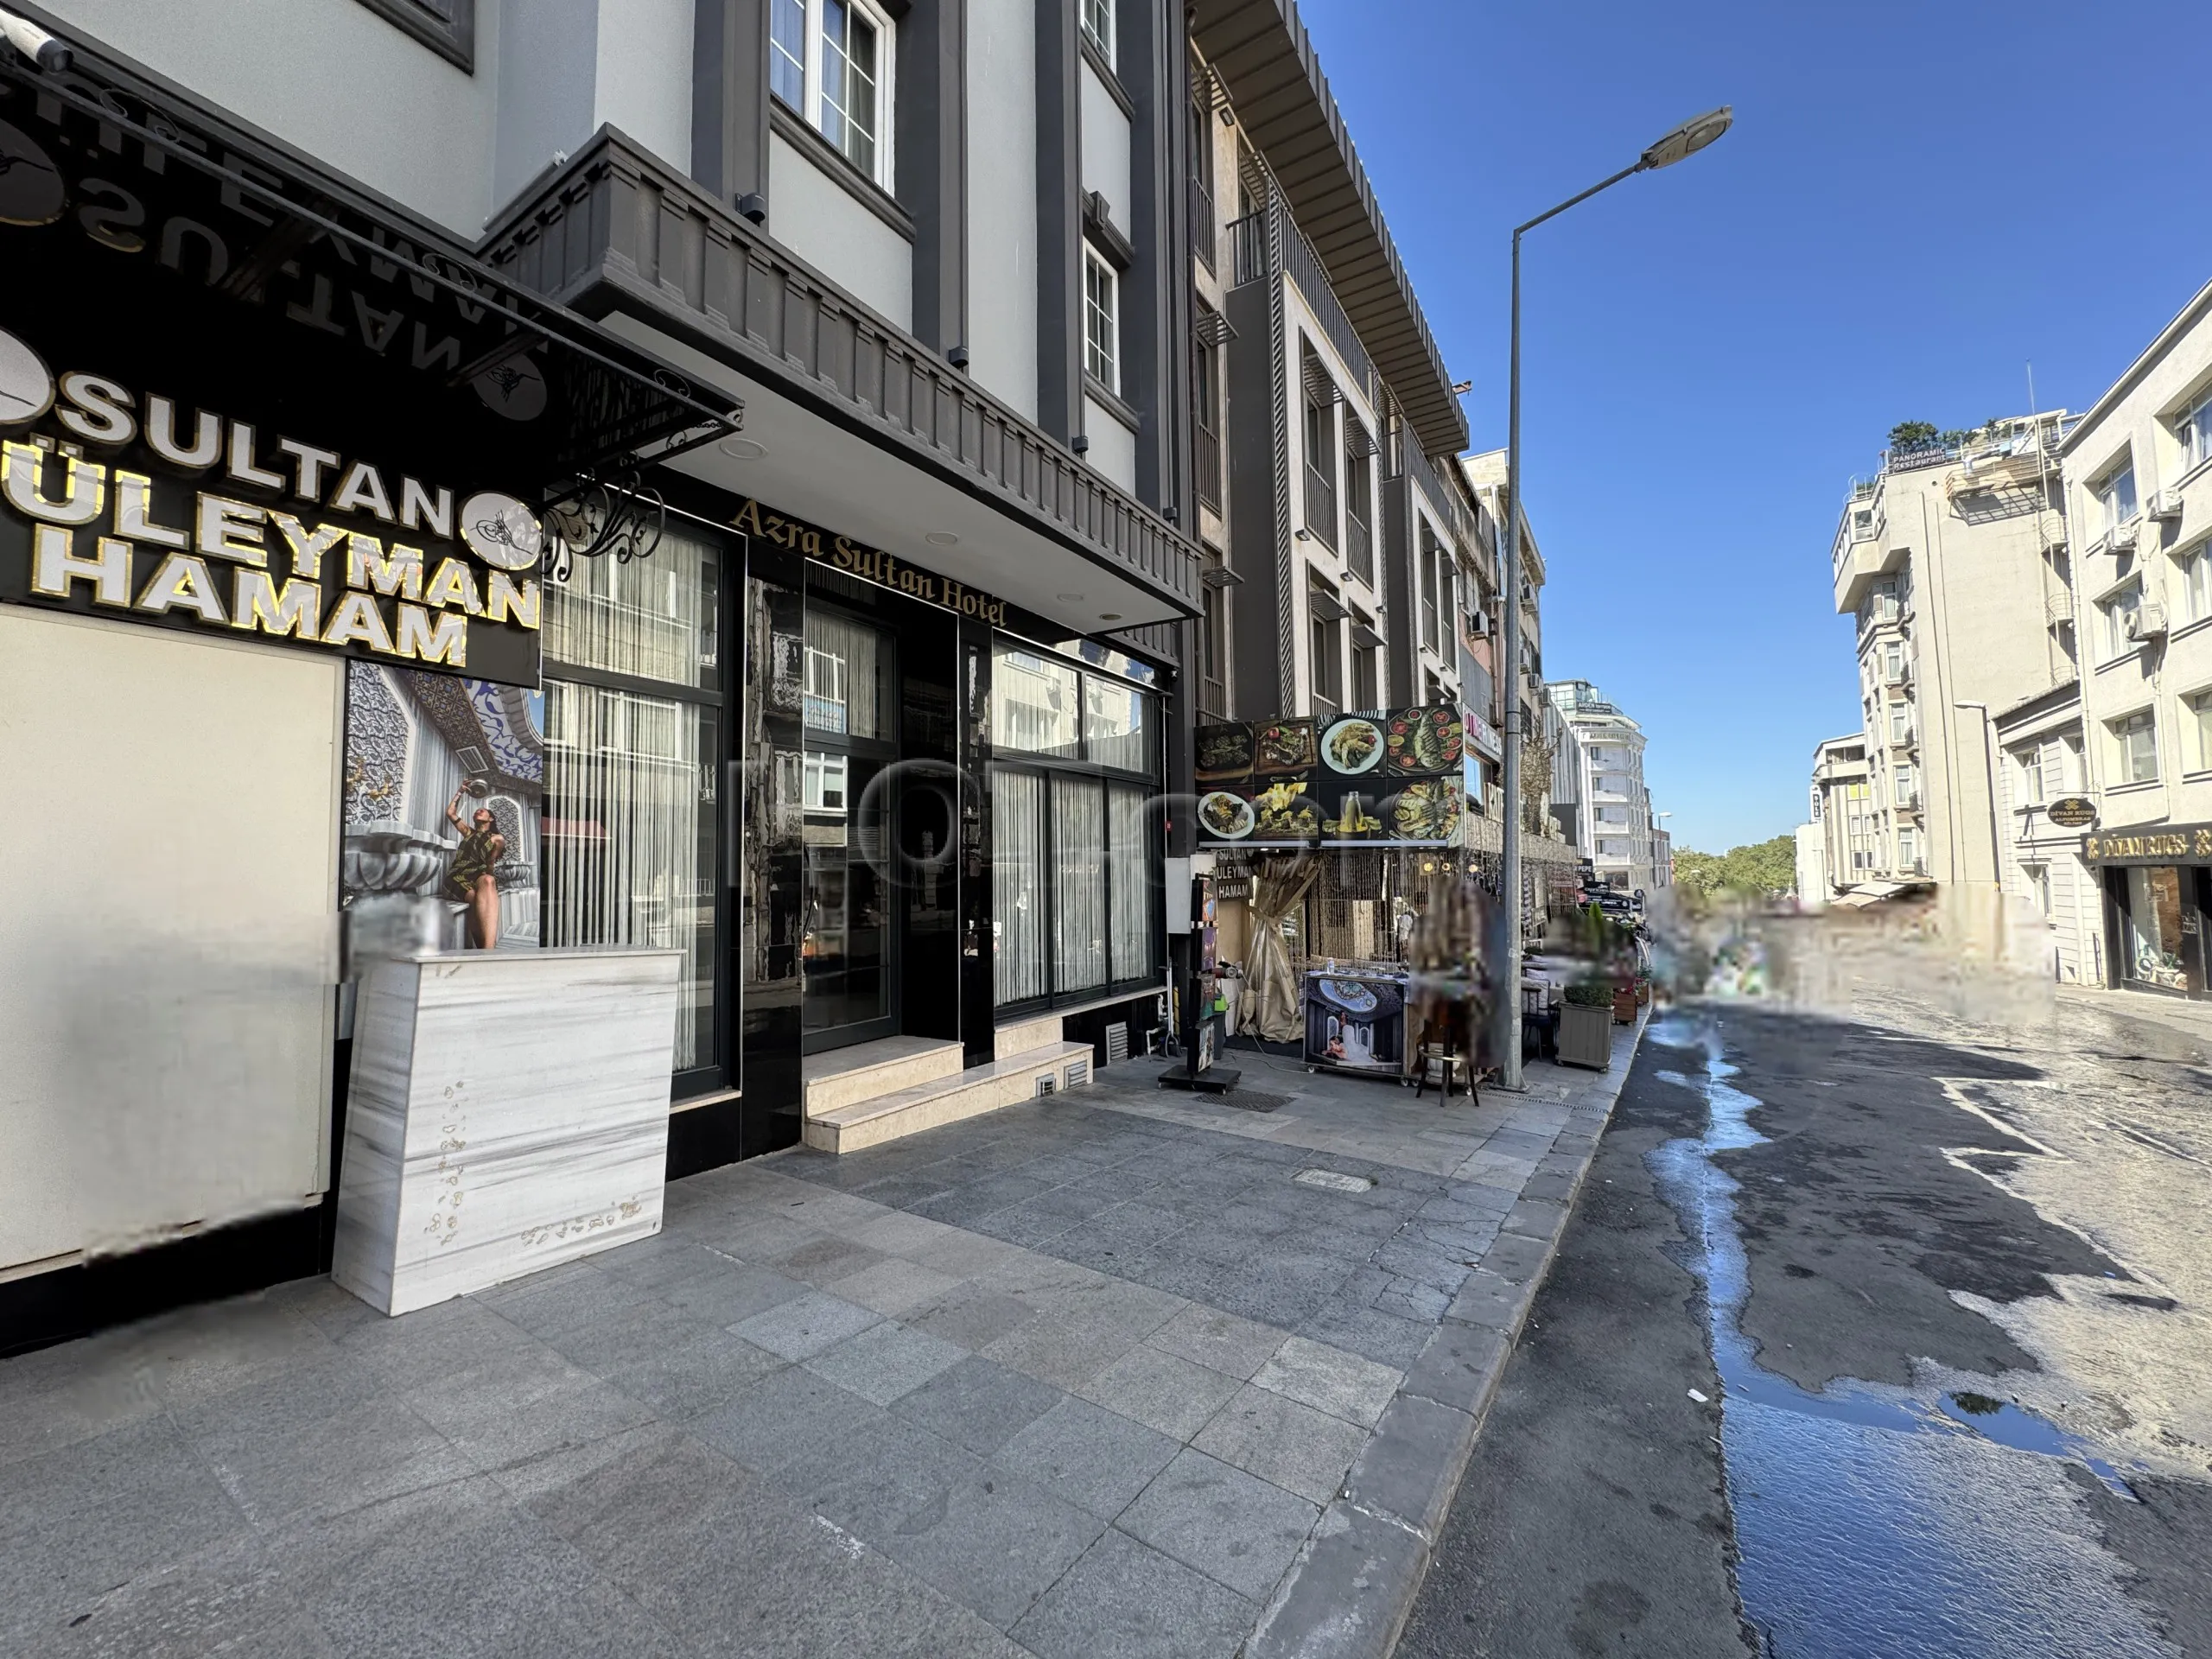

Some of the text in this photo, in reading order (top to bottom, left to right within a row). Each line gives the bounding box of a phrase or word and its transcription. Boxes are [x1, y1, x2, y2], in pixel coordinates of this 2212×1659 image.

[58, 369, 455, 541] SULTAN
[1892, 447, 1945, 463] PANORAMIC
[1893, 454, 1946, 471] Restaurant
[1, 431, 541, 631] ÜLEYMAN
[728, 497, 1007, 627] Azra Sultan Hotel
[30, 522, 468, 668] HAMAM
[1219, 848, 1247, 861] SULTAN
[1218, 884, 1249, 899] HAMAM
